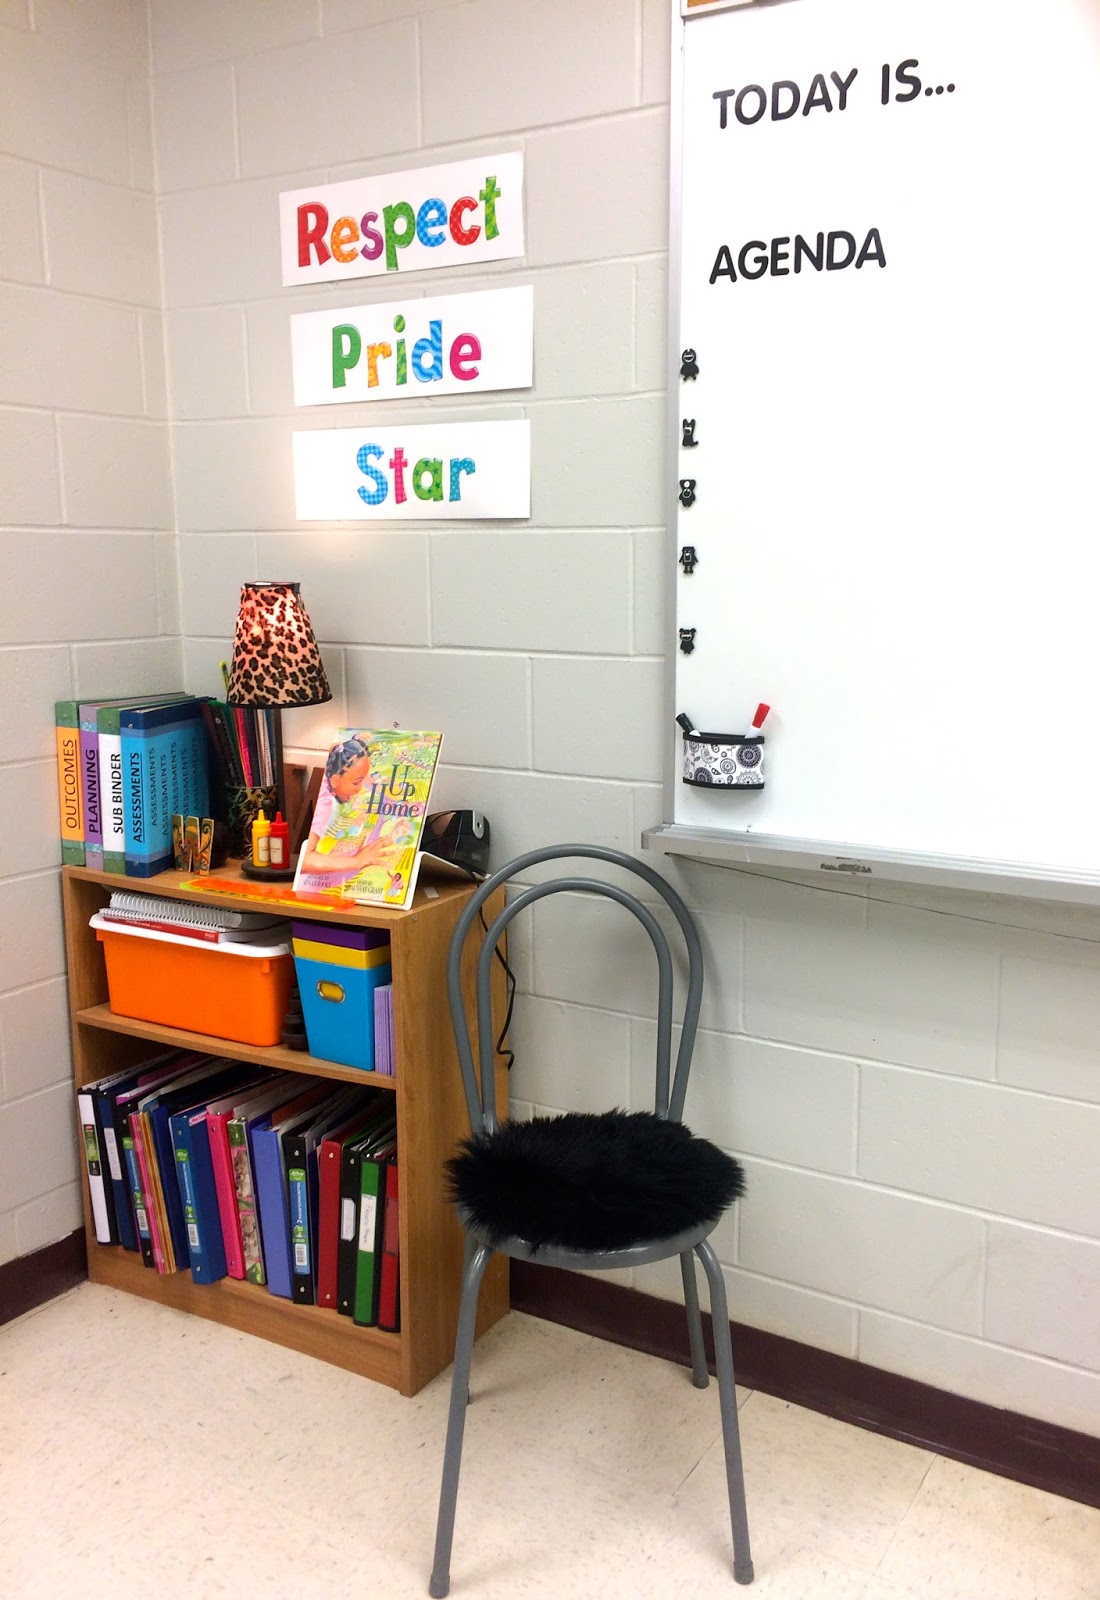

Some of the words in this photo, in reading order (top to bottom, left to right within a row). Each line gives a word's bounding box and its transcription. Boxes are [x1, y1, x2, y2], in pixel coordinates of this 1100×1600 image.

[712, 68, 858, 130] TODAY
[880, 58, 956, 106] IS...
[296, 175, 501, 272] Respect
[709, 227, 887, 285] AGENDA
[331, 313, 482, 389] Pride
[356, 442, 476, 506] Star
[63, 739, 79, 829] OUTCOMES
[85, 749, 99, 833] PLANNING
[110, 753, 122, 803] BINDER
[129, 752, 143, 843] ASSESSMENTS
[148, 747, 158, 826] ASSESSMENTS
[160, 753, 169, 836] ASSESSMENTS
[366, 782, 419, 817] Home
[389, 764, 416, 801] Up
[112, 807, 123, 834] SUB
